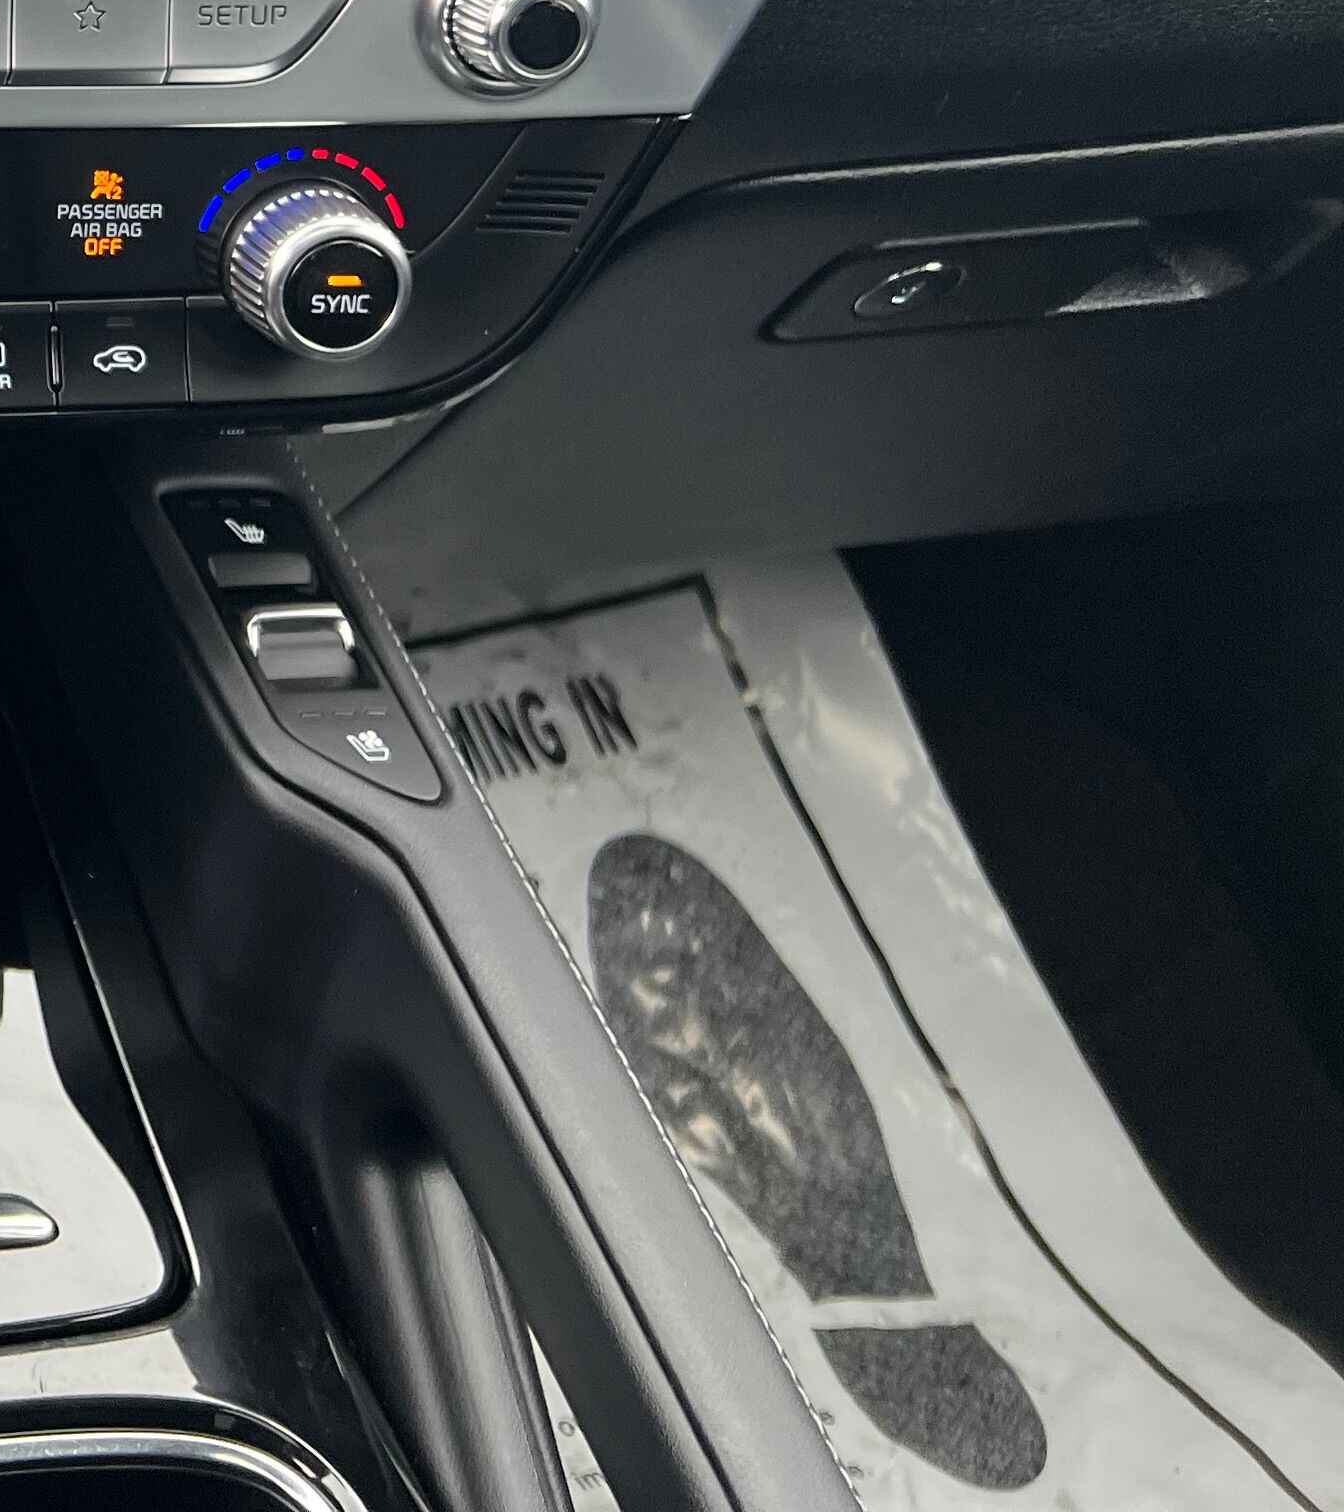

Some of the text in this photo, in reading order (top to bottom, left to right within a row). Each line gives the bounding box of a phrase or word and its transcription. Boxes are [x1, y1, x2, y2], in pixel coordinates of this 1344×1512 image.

[195, 3, 288, 29] SETUP
[57, 203, 163, 220] PASSENGER
[70, 222, 143, 238] AIR BAG
[84, 237, 124, 256] OFF
[310, 293, 371, 316] SYNC
[565, 671, 639, 758] IN
